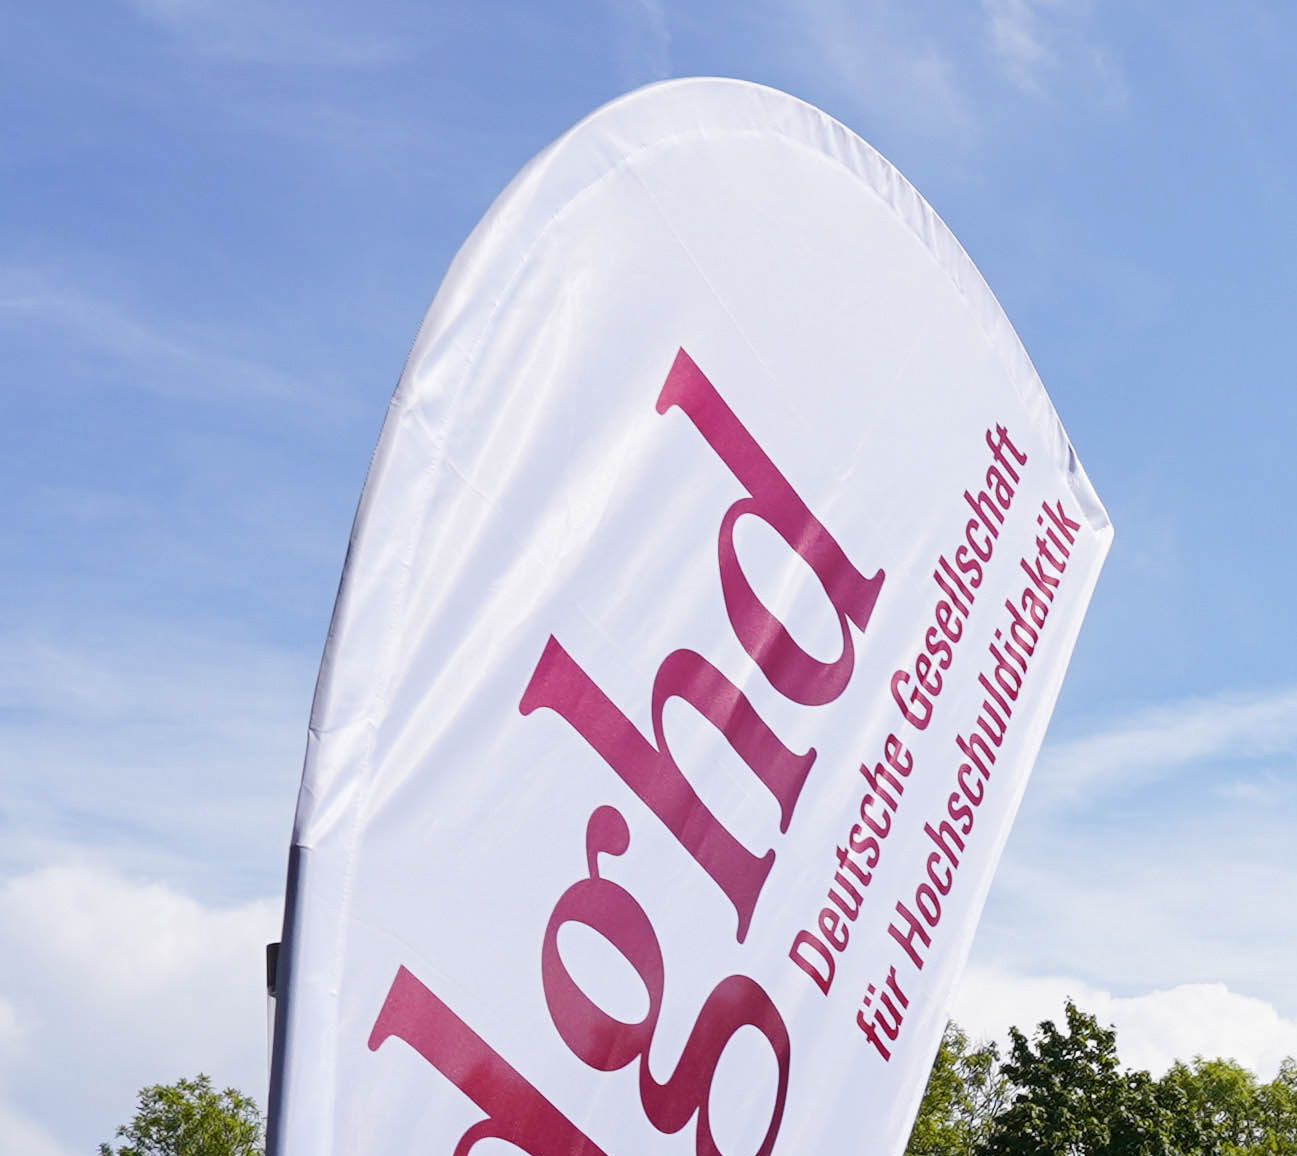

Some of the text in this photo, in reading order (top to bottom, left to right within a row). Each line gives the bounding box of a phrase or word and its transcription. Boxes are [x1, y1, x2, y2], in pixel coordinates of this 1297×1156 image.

[788, 424, 1028, 996] Deutsche Gesellschaft
[856, 501, 1081, 1062] für Hochschuldidaktik
